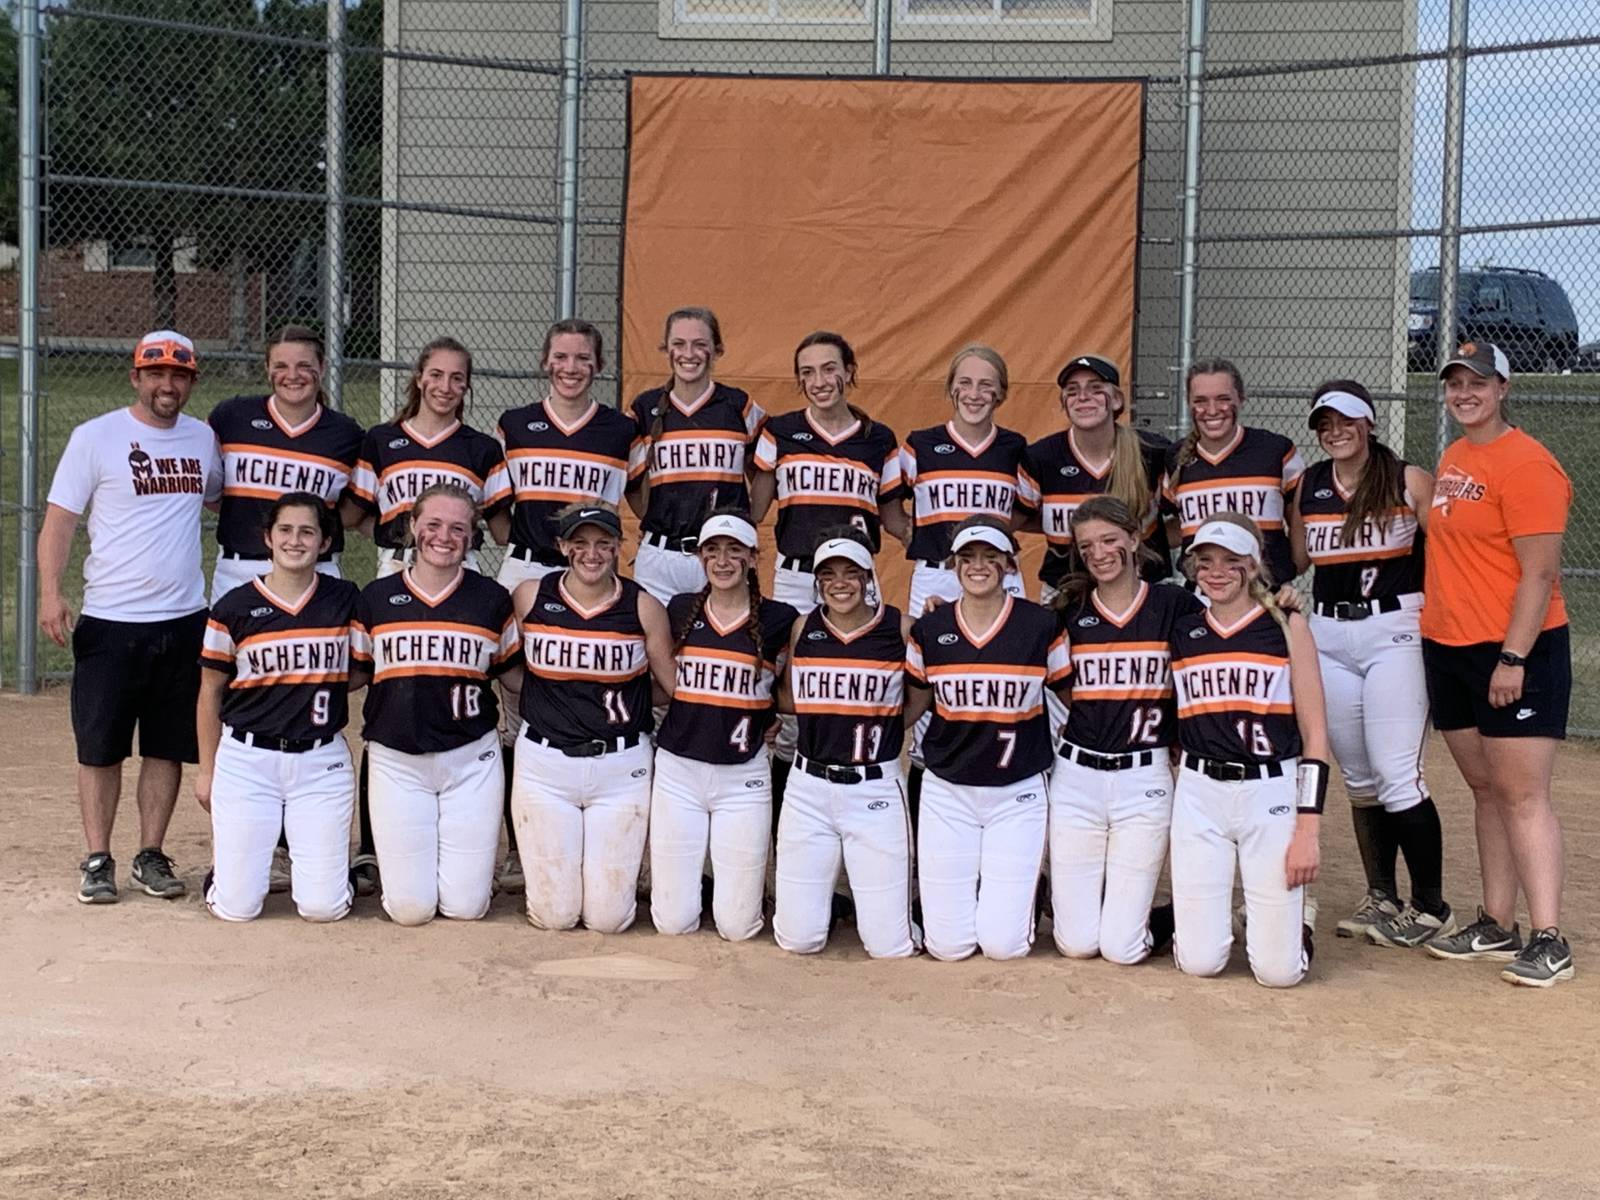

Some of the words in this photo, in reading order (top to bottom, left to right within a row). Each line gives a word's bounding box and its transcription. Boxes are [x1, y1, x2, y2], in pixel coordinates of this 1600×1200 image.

[154, 457, 179, 475] WE
[180, 457, 202, 475] ARE
[235, 458, 336, 497] MCHENRY
[519, 460, 612, 492] MCHENRY
[132, 475, 204, 496] WARRIORS
[247, 641, 345, 675] MCHENRY
[381, 635, 484, 666] MCHENRY
[532, 638, 635, 671] MCHENRY
[311, 689, 331, 726] 9
[603, 688, 631, 724] 11
[729, 715, 750, 753] 4
[851, 722, 883, 762] 13
[1127, 706, 1162, 744] 12
[996, 730, 1017, 769] 7
